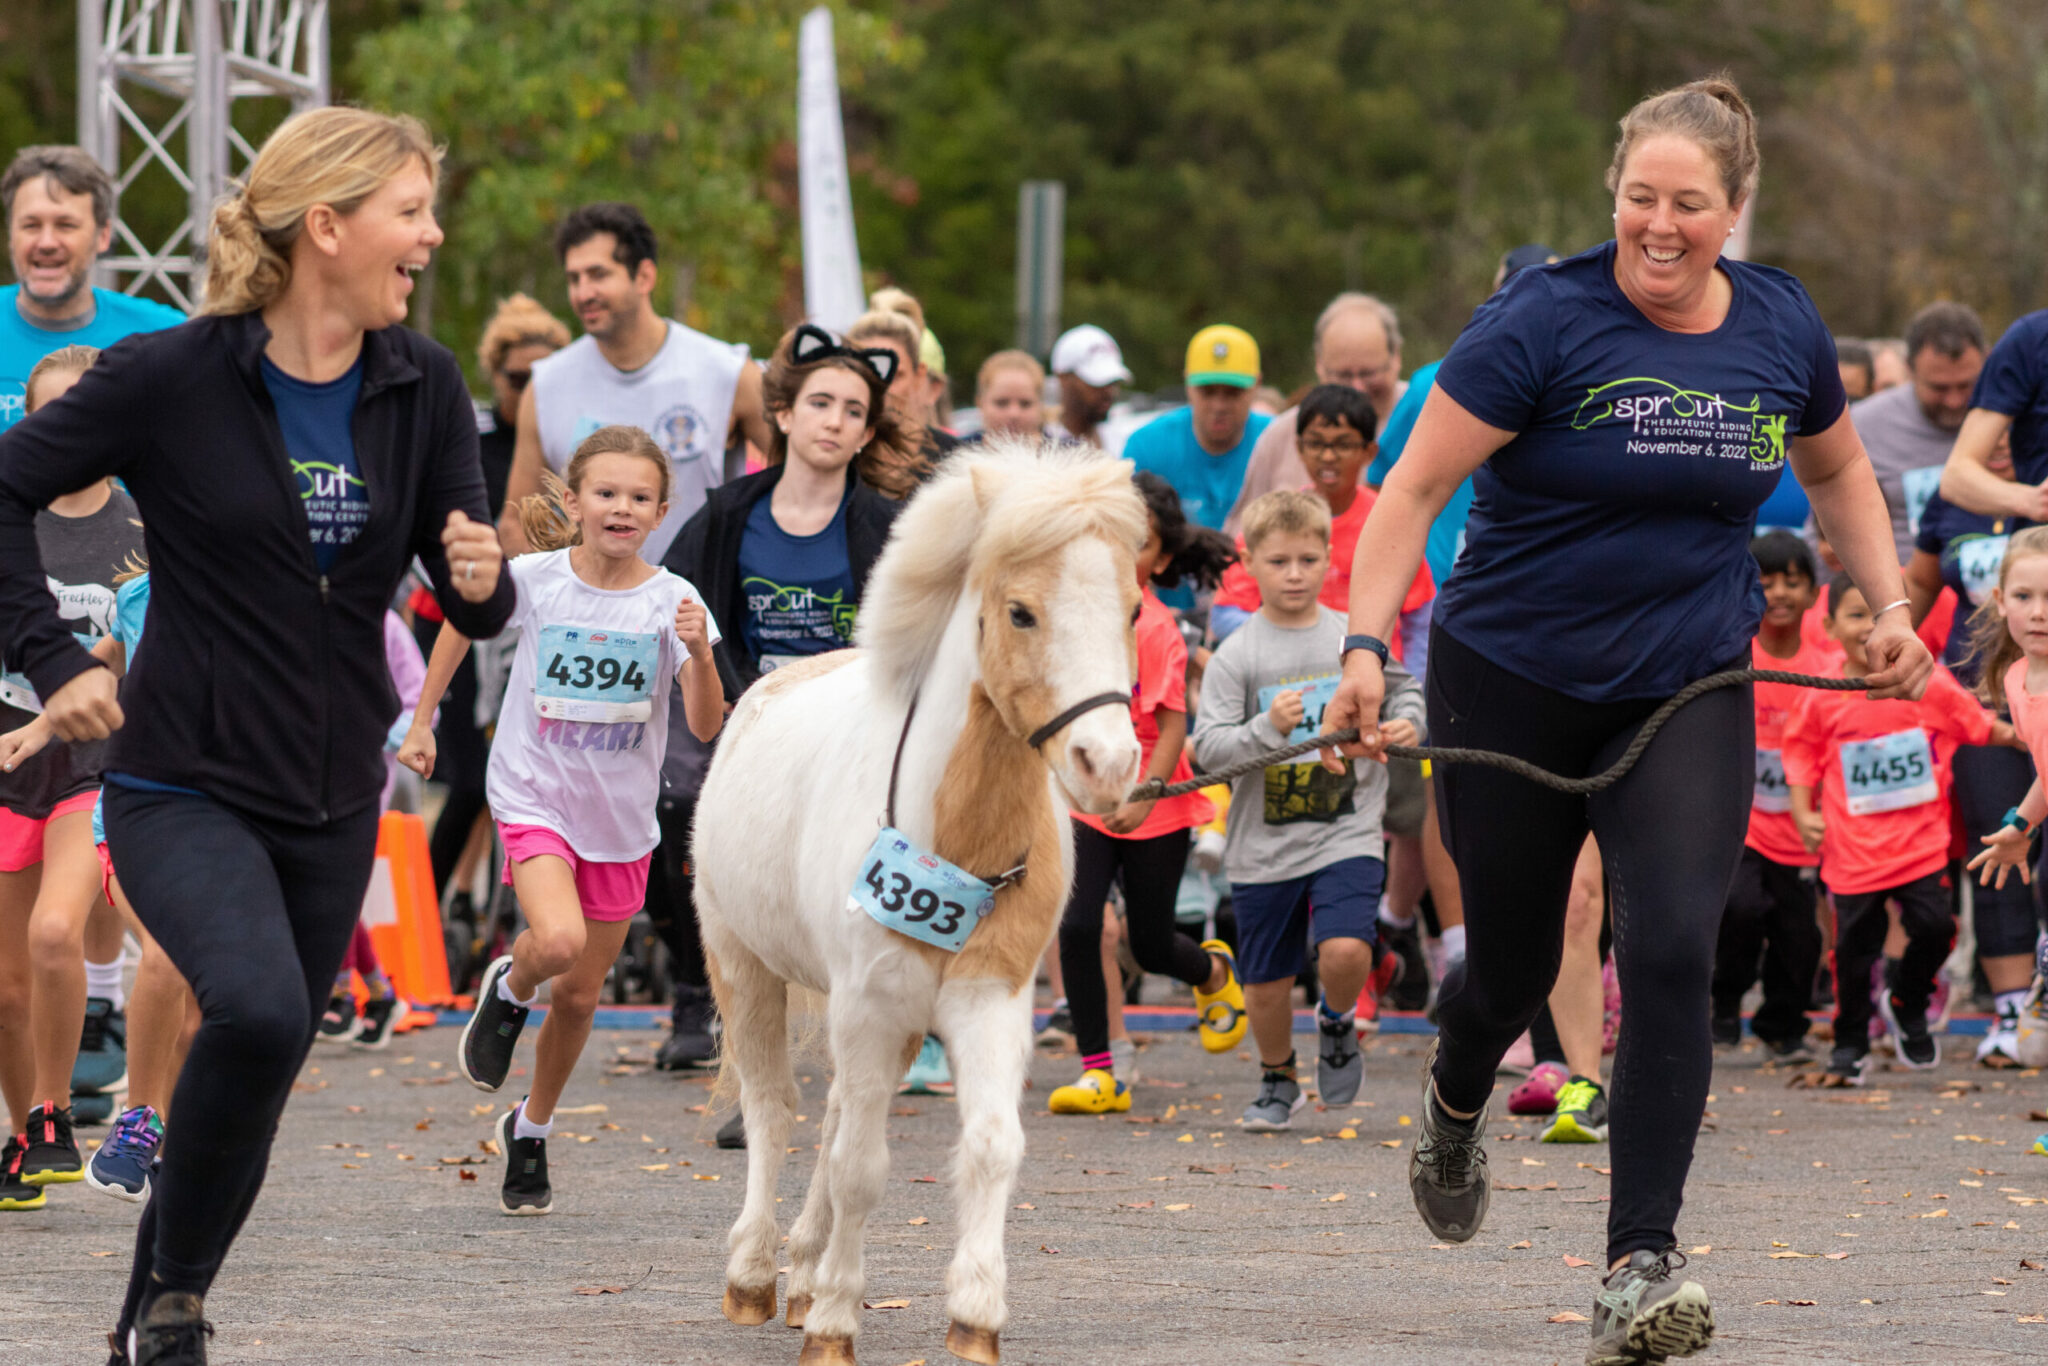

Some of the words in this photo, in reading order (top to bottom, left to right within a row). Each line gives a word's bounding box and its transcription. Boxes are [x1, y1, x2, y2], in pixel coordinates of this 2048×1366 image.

[1614, 392, 1727, 432] sprout
[1644, 419, 1715, 430] THERAPEUTIC
[1719, 422, 1752, 432] RIDING
[1626, 440, 1703, 455] November
[1705, 443, 1716, 458] 6,
[1719, 444, 1748, 459] 2022
[1642, 428, 1649, 436] &
[1654, 428, 1711, 438] EDUCATION
[1714, 431, 1749, 441] CENTER
[57, 590, 107, 606] Freckles
[748, 587, 815, 622] sprout
[546, 653, 646, 692] 4394
[1851, 752, 1924, 786] 4455
[865, 859, 966, 935] 4393
